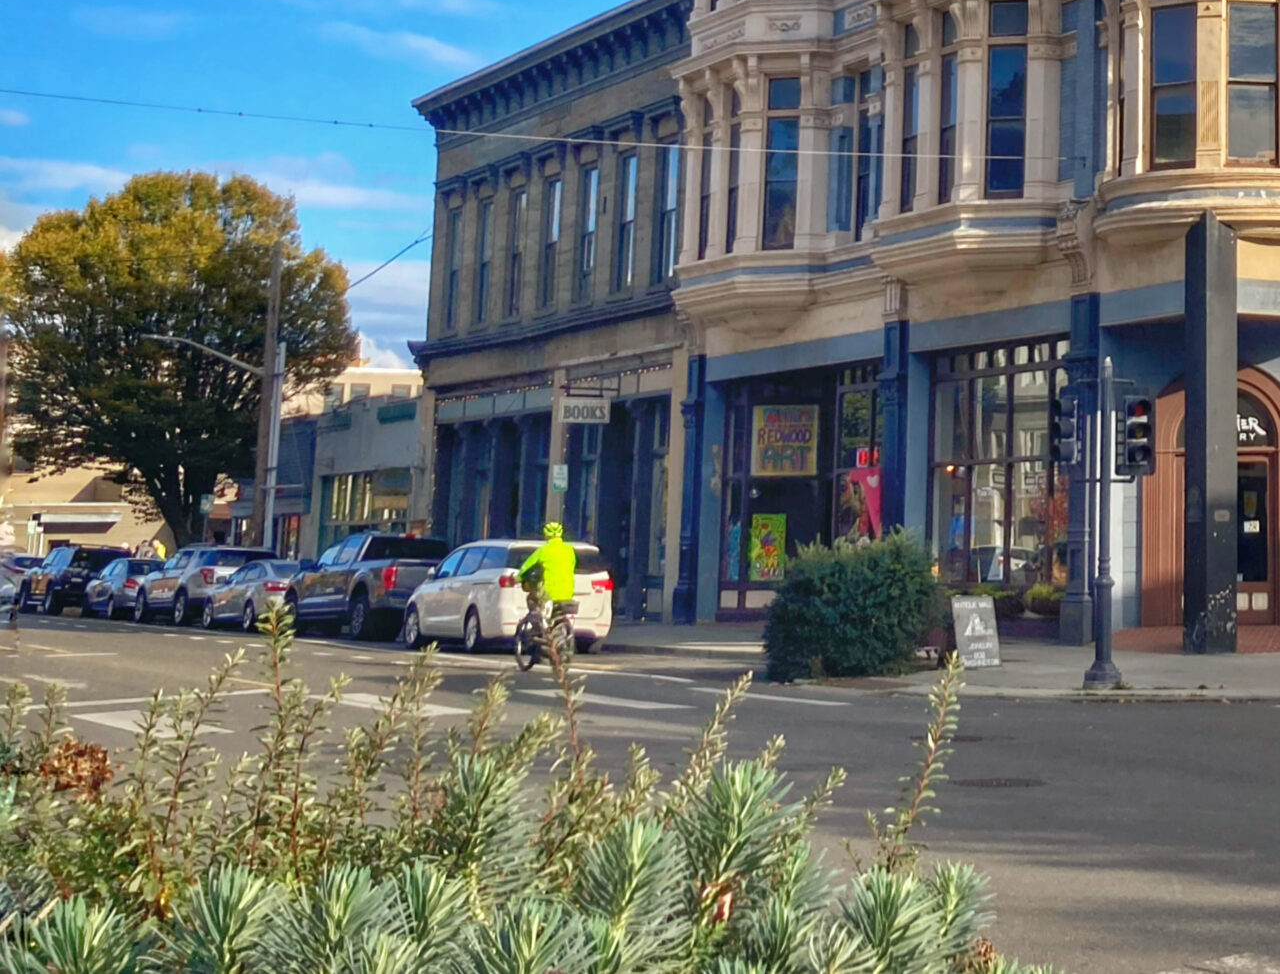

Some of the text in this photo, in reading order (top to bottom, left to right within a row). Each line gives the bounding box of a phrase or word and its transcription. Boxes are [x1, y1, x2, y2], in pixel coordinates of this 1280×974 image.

[563, 405, 606, 419] BOOKS
[758, 429, 812, 444] REDWOOD
[761, 446, 811, 469] ART
